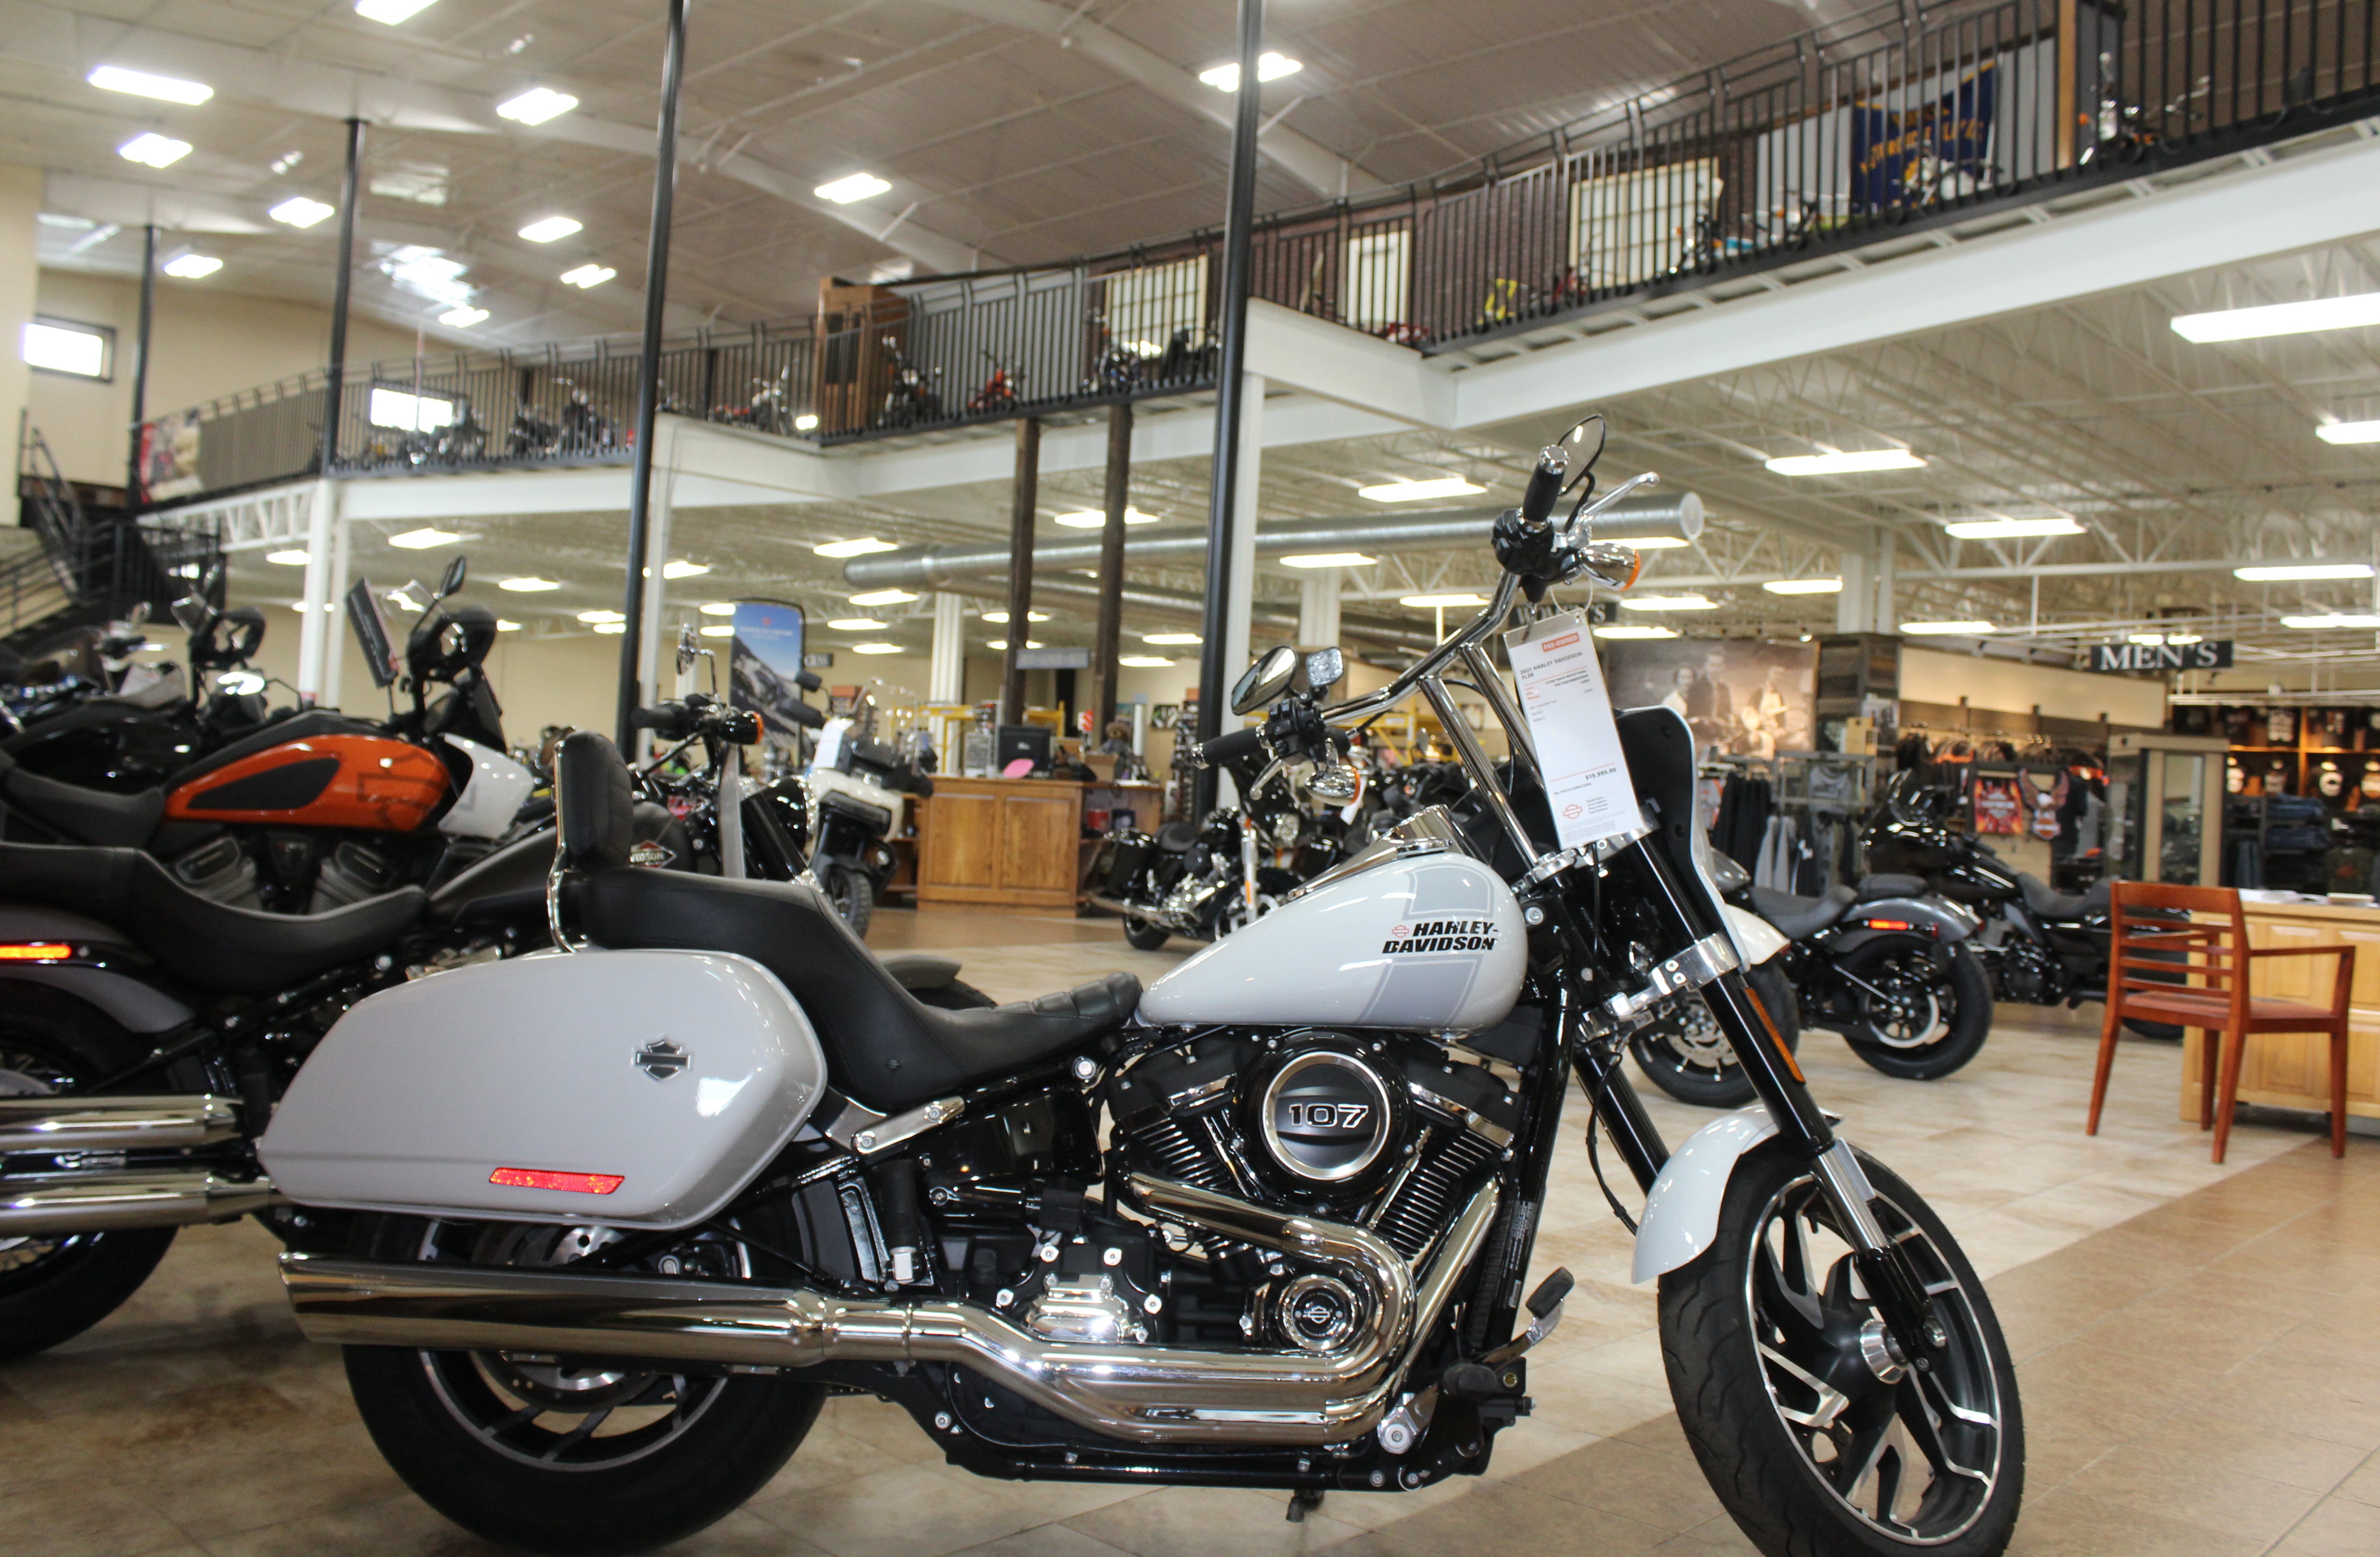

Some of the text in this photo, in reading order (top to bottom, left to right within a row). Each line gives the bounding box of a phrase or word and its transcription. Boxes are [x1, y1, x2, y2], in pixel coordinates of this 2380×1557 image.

[1533, 661, 1553, 671] HARLEY
[1554, 651, 1583, 664] DAVIDSON
[2100, 642, 2218, 670] MEN'S
[1412, 921, 1498, 937] HARLEY-
[1382, 937, 1498, 954] DAVIDSON
[1288, 1103, 1369, 1128] 107
